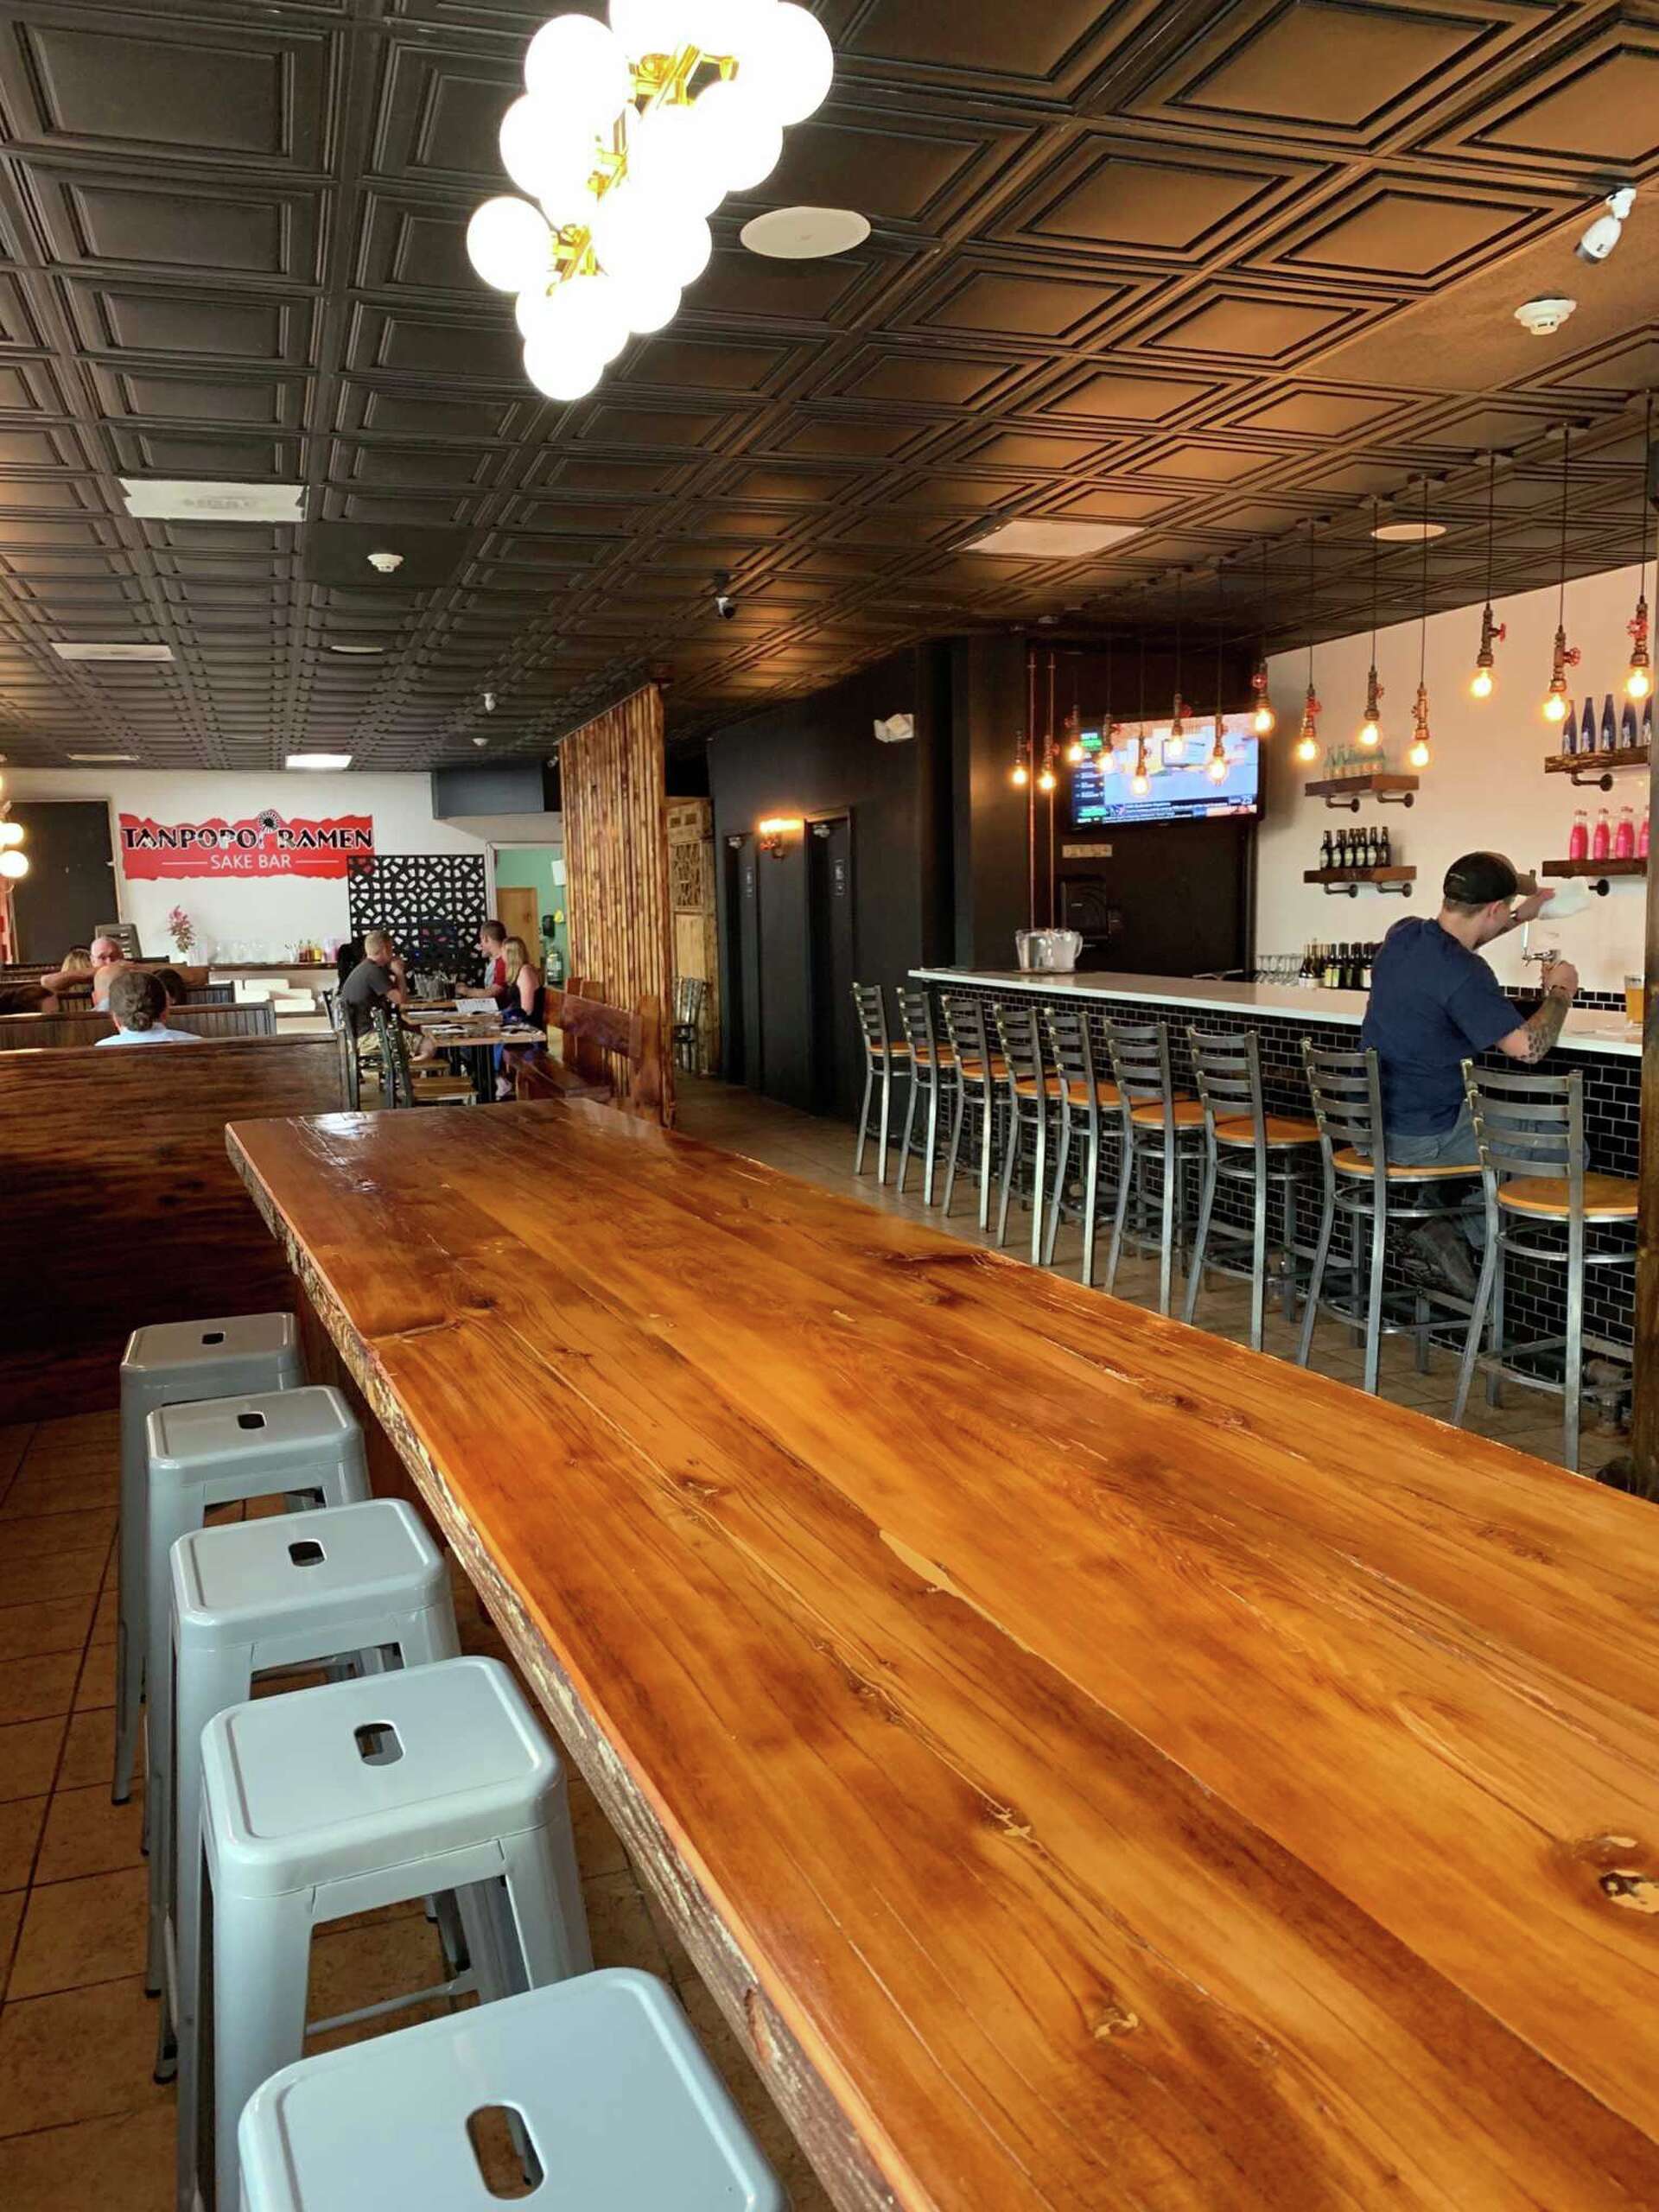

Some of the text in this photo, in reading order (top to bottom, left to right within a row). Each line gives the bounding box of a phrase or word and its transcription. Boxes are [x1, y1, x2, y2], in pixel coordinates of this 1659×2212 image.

[121, 827, 372, 849] TANPOPO RAMEN
[210, 853, 291, 869] SAKE BAR
